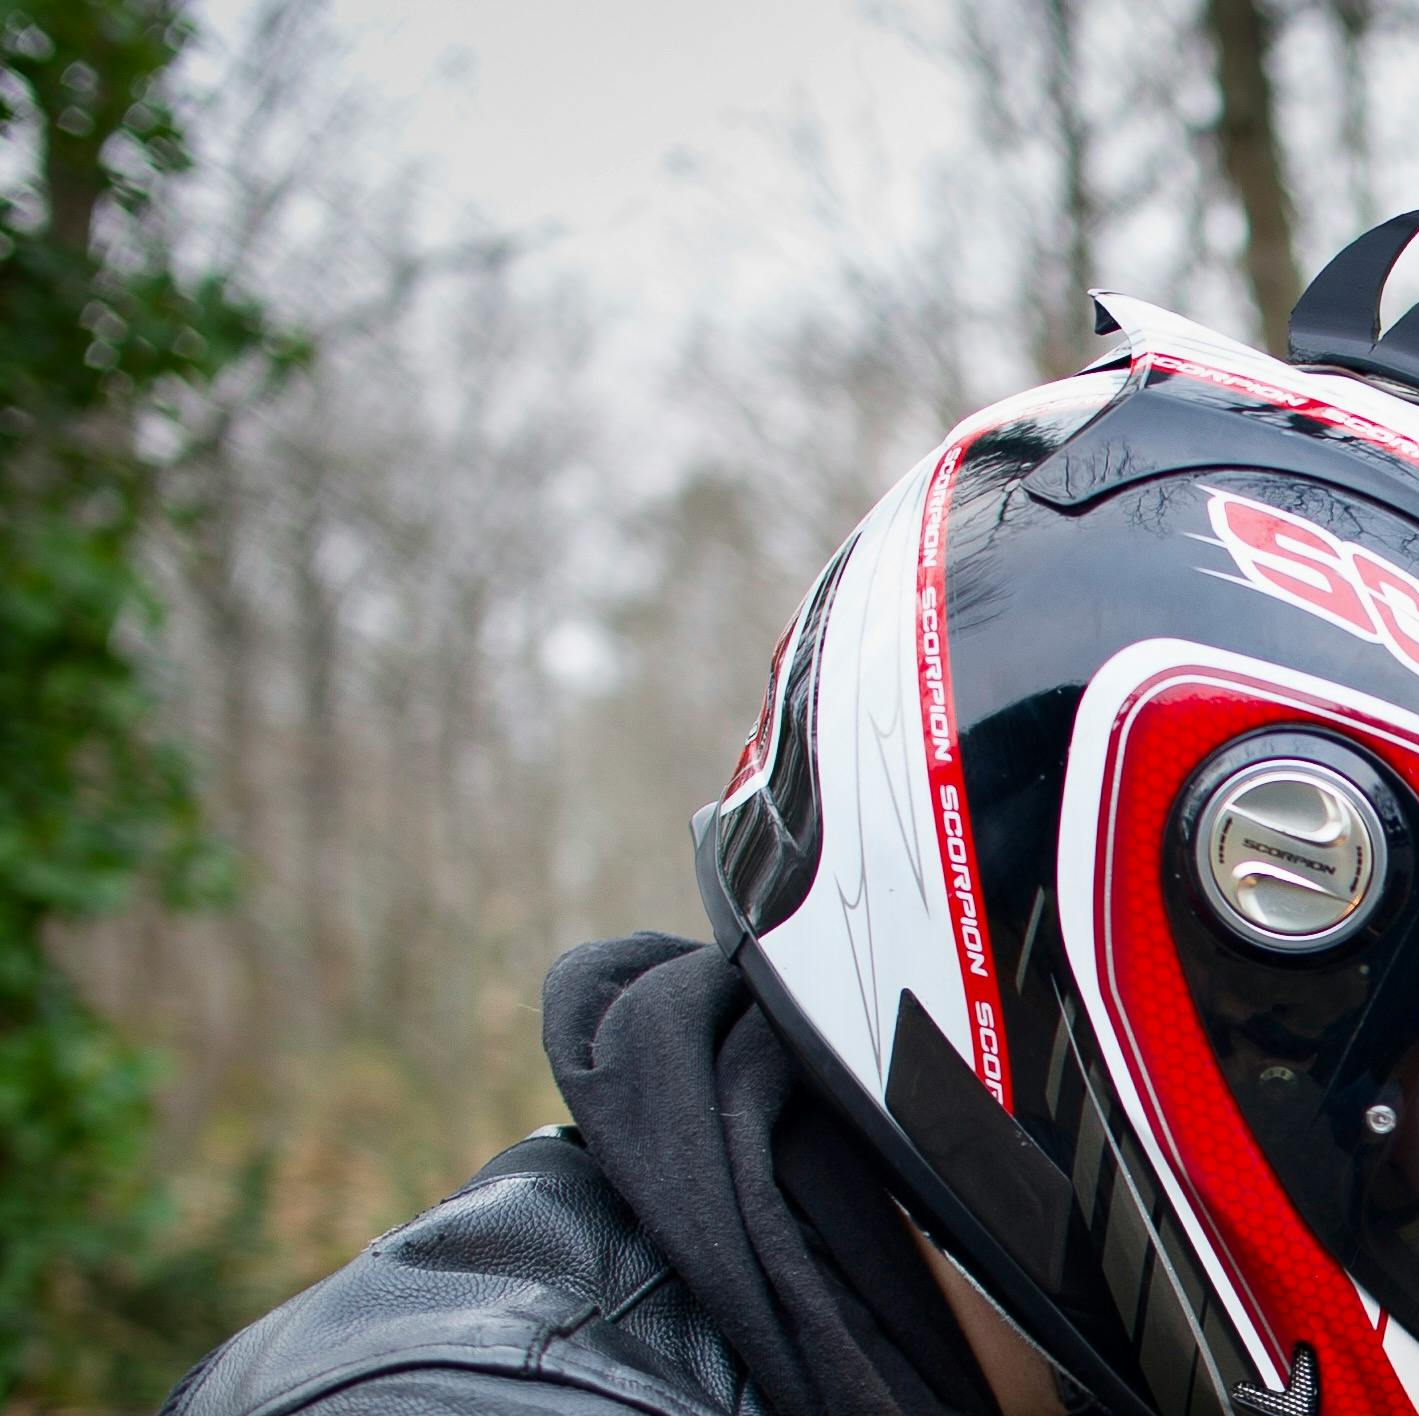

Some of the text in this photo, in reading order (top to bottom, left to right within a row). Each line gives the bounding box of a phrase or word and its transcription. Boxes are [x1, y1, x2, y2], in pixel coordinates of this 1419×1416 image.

[922, 446, 963, 567] SCORPION
[921, 586, 953, 762] SCORPION
[940, 784, 988, 978] SCORPION
[1241, 837, 1338, 877] SCORPION
